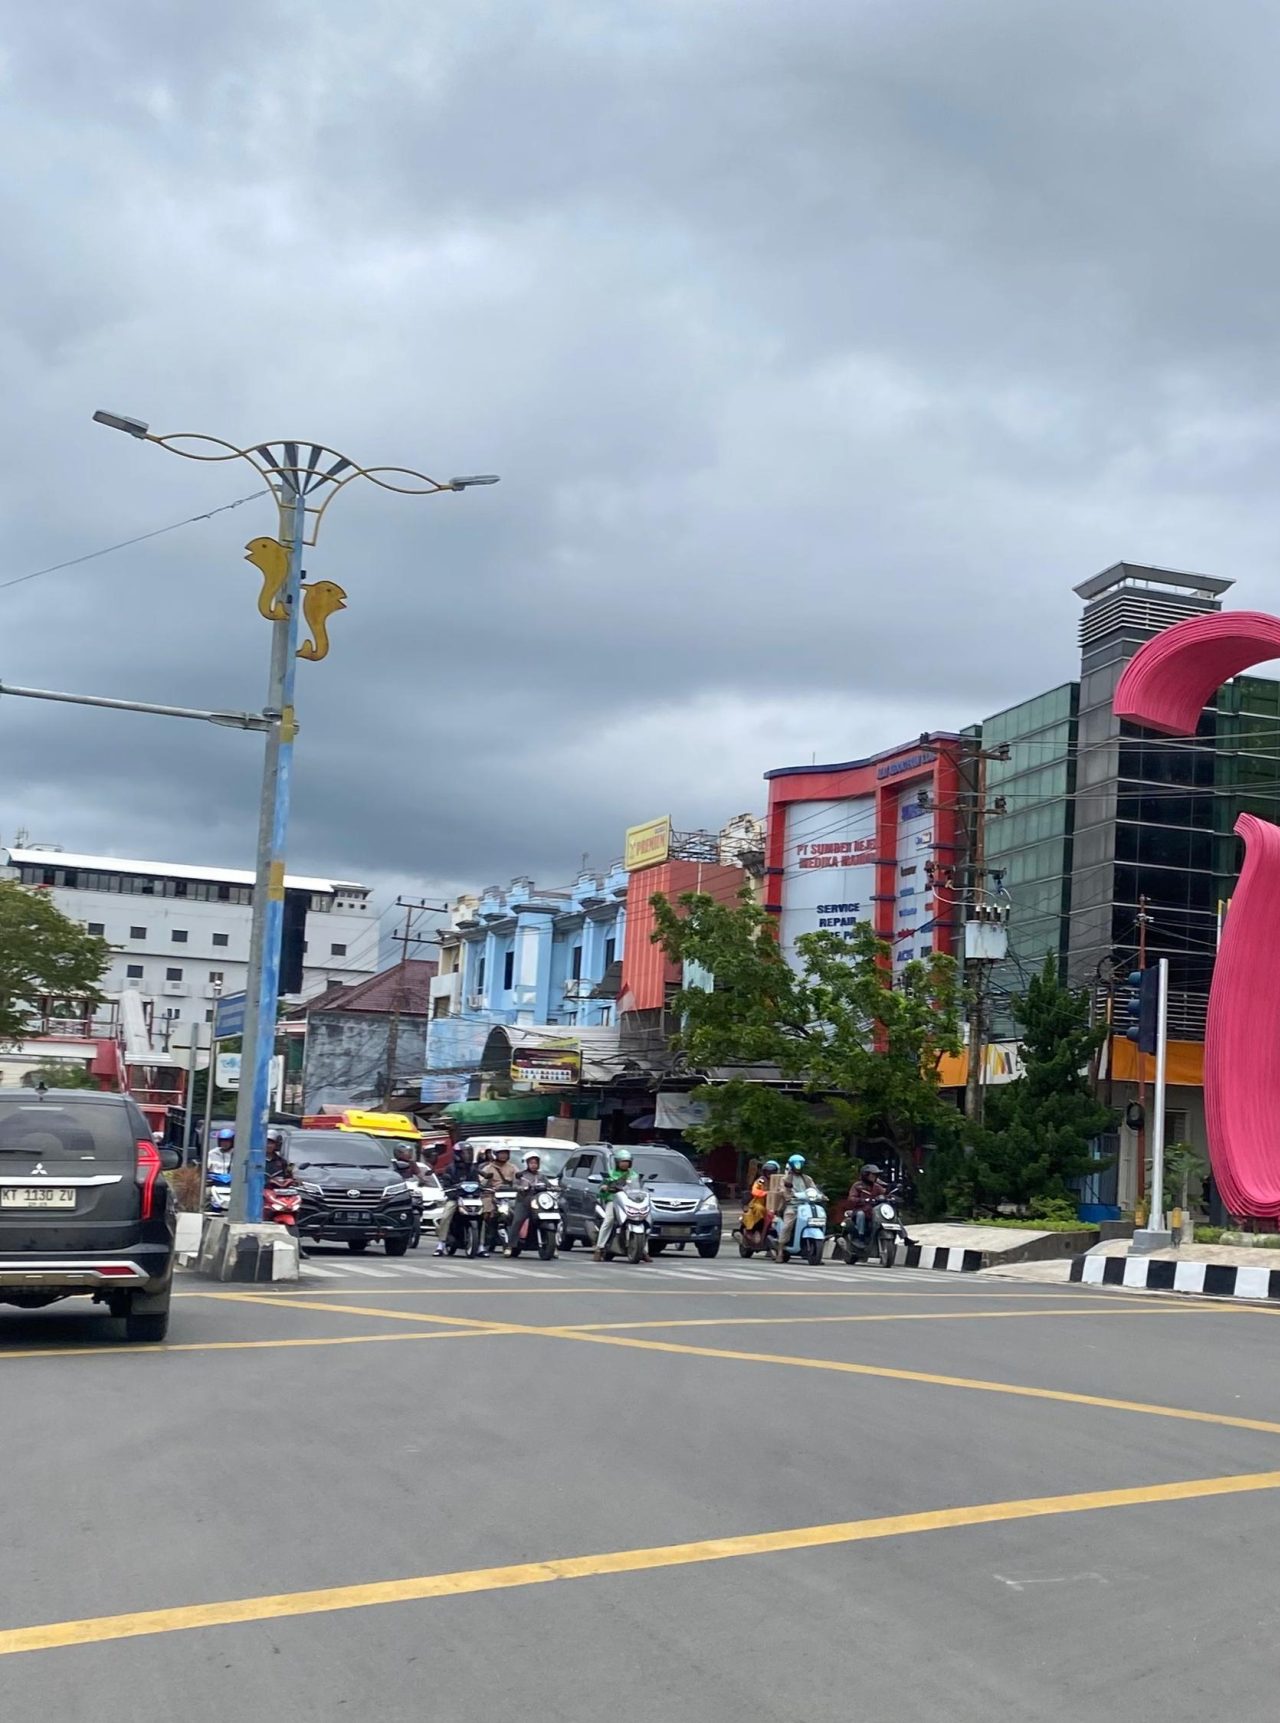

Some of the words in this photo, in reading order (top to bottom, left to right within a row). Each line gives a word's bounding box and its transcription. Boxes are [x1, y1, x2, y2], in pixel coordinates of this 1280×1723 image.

[797, 844, 808, 856] PT
[816, 902, 860, 914] SERVICE
[819, 916, 857, 928] REPAIR
[2, 1189, 17, 1201] KT
[24, 1189, 54, 1201] 1130
[59, 1189, 74, 1201] ZV
